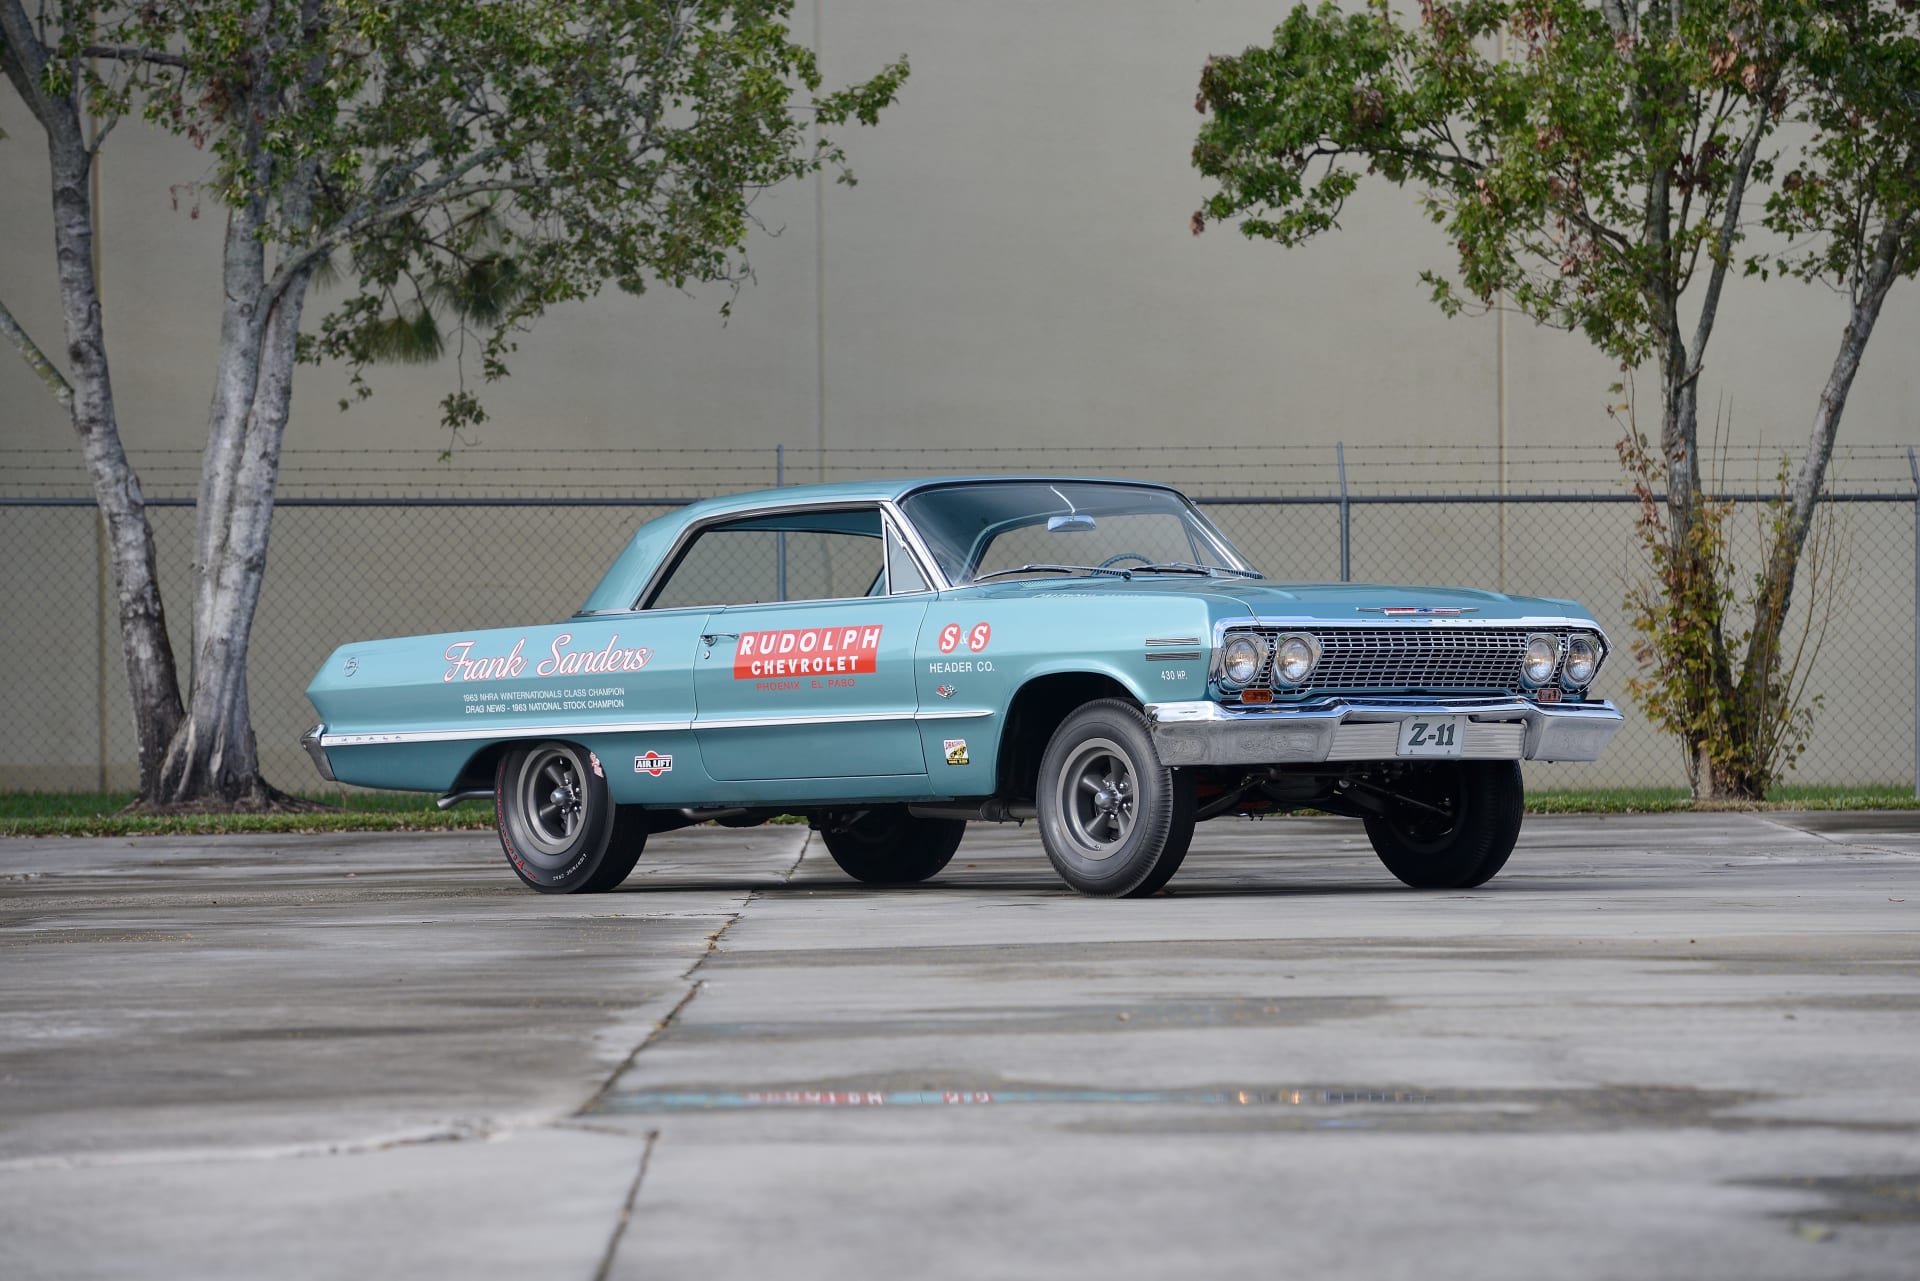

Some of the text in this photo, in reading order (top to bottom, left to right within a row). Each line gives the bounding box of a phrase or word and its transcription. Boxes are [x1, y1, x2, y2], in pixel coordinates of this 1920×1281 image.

[739, 628, 880, 655] RUDOLPH
[941, 626, 958, 650] S
[971, 625, 988, 649] S
[444, 634, 654, 683] Frank Sanders
[751, 656, 859, 675] CHEVROLET
[929, 661, 995, 673] HEADER CO.
[1161, 670, 1175, 680] 430
[755, 679, 855, 691] PHOENIX EL PASO
[464, 688, 624, 702] 1963 NHRA WINTERNATIONALS CLASS CHAMPION
[466, 705, 484, 713] DRAG
[487, 704, 505, 713] NEWS
[529, 702, 561, 711] NATIONAL
[563, 701, 586, 709] STOCK
[588, 699, 624, 708] CHAMPION
[1408, 723, 1455, 746] Z-11
[637, 760, 651, 768] AIR
